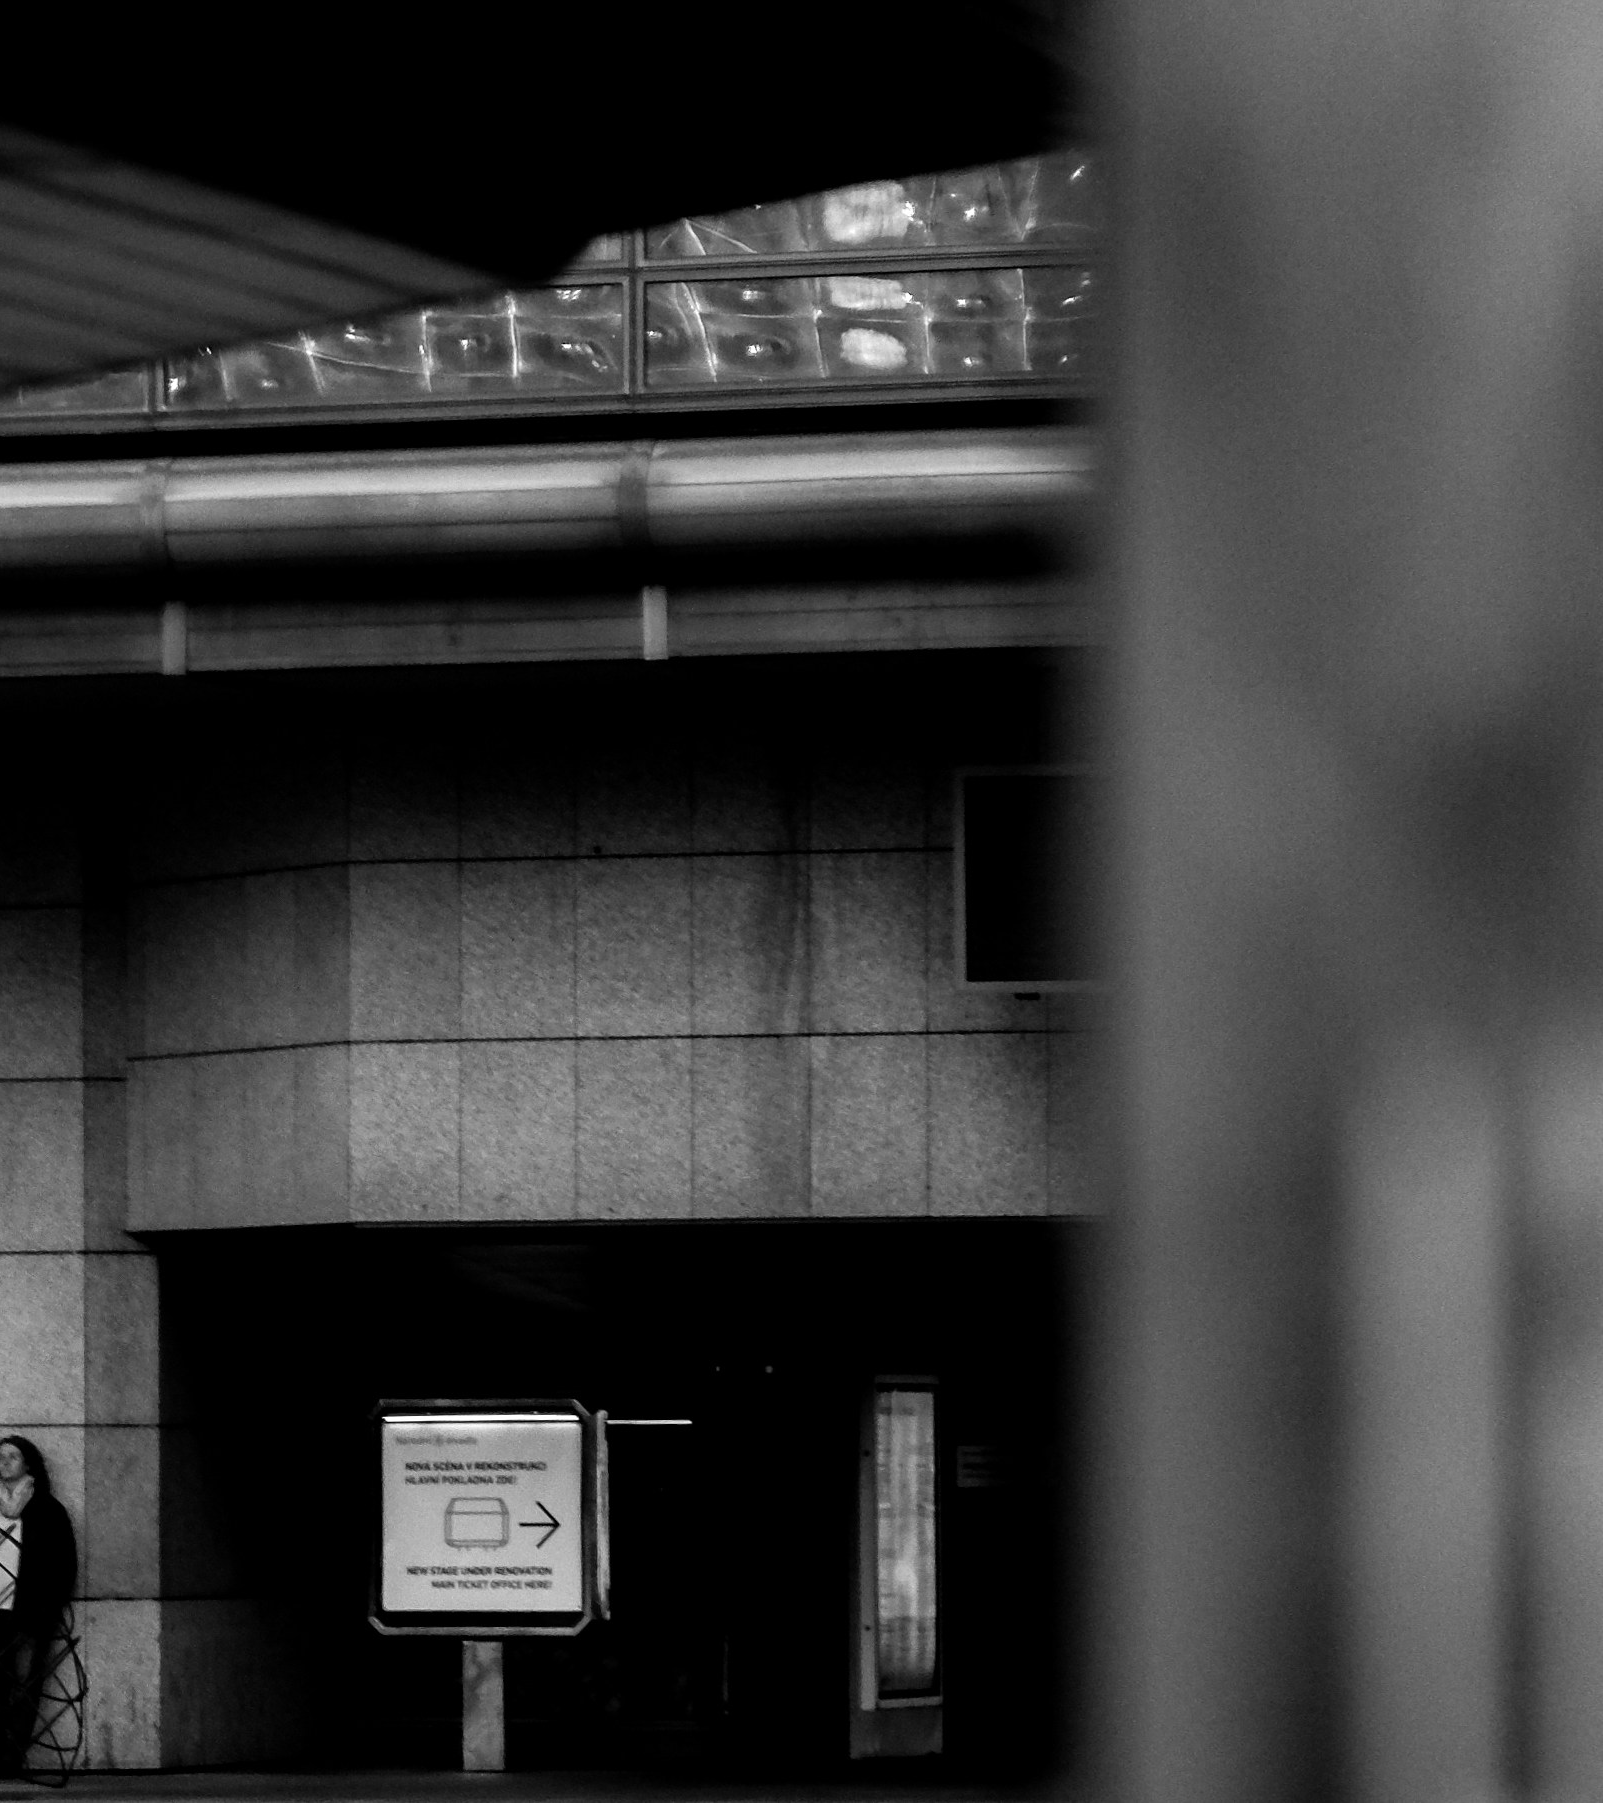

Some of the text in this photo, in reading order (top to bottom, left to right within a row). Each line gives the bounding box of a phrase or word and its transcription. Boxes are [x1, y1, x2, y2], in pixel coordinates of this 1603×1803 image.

[406, 1565, 553, 1576] NEW STAGE UNDER RENOVATION
